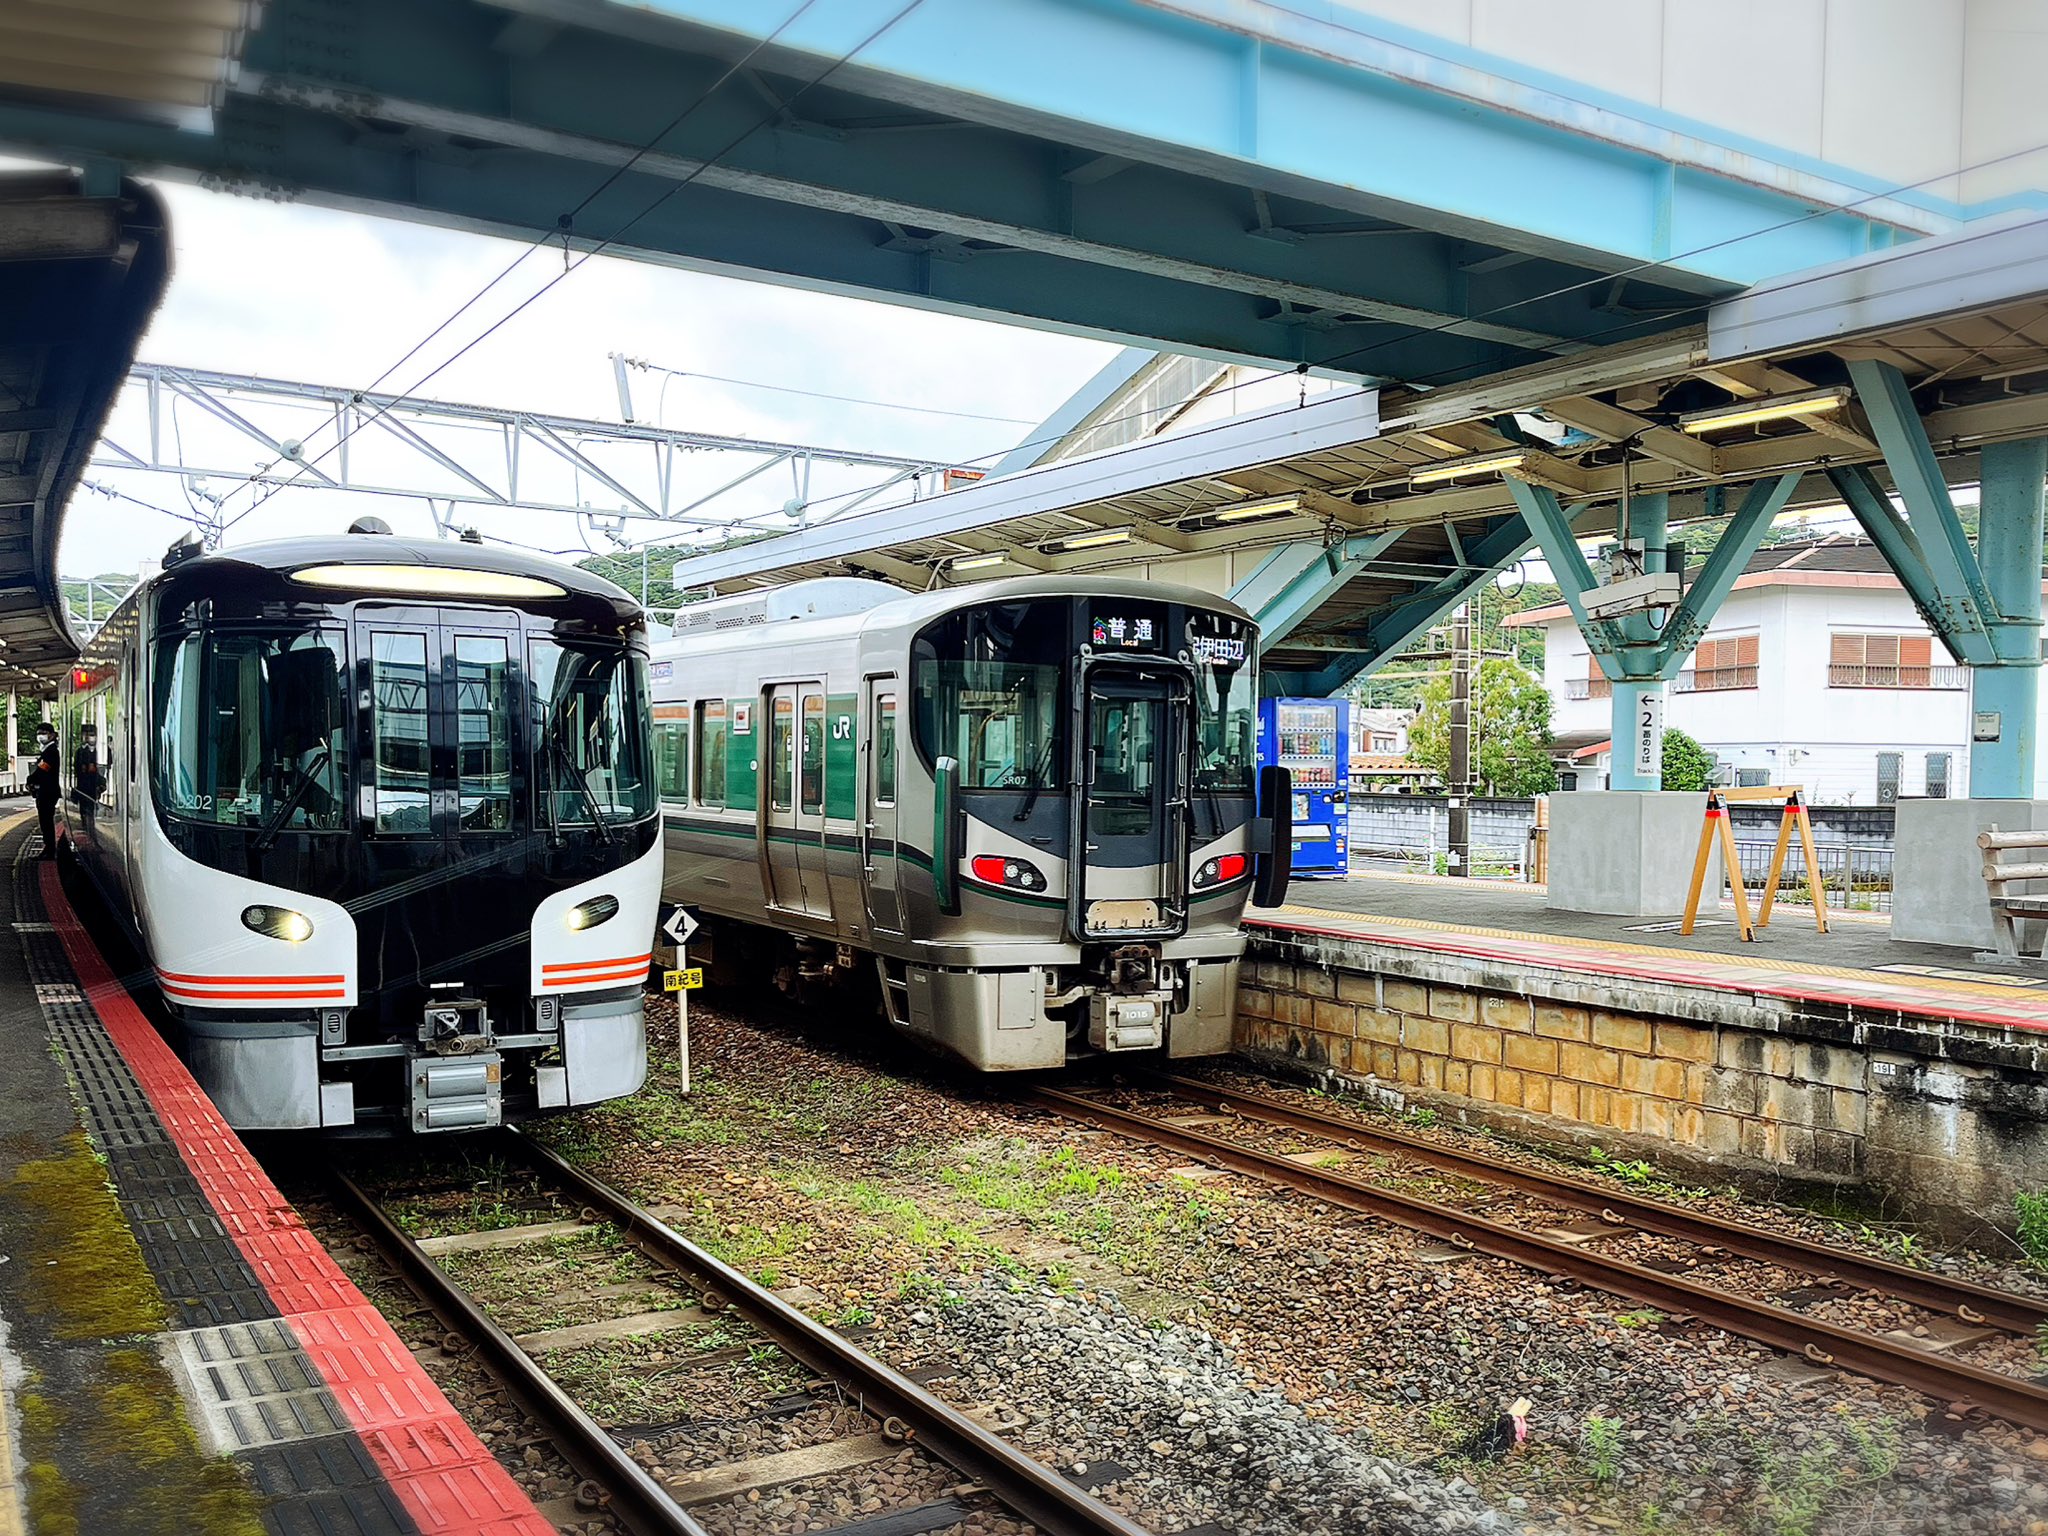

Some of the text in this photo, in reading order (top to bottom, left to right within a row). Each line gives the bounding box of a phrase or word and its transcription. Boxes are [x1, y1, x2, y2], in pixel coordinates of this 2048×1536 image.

[1108, 617, 1153, 641] 普通
[1121, 638, 1139, 647] Local
[833, 715, 851, 739] JR
[1003, 776, 1027, 785] SR07
[674, 915, 688, 936] 4
[665, 972, 702, 988] 南紀号
[1125, 1010, 1149, 1019] 1015
